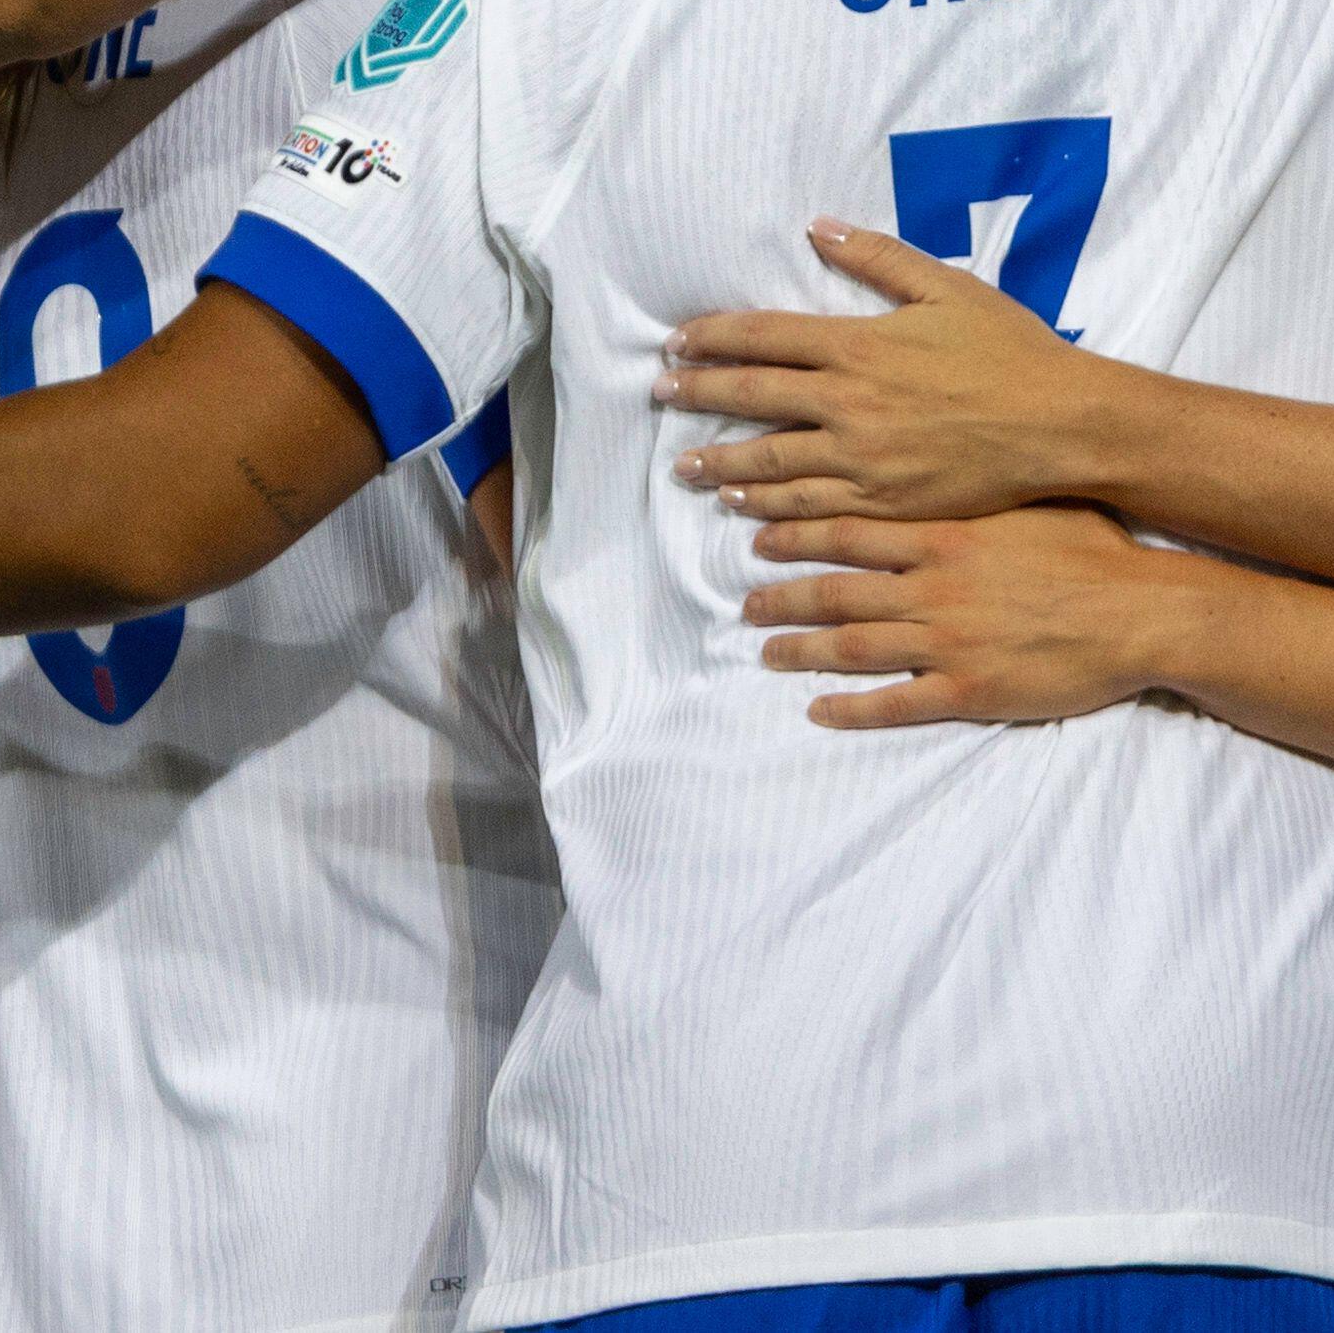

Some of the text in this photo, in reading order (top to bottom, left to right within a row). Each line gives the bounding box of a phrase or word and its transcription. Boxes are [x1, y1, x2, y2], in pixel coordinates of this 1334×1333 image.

[283, 130, 376, 184] ATION 10
[889, 116, 1112, 344] 7
